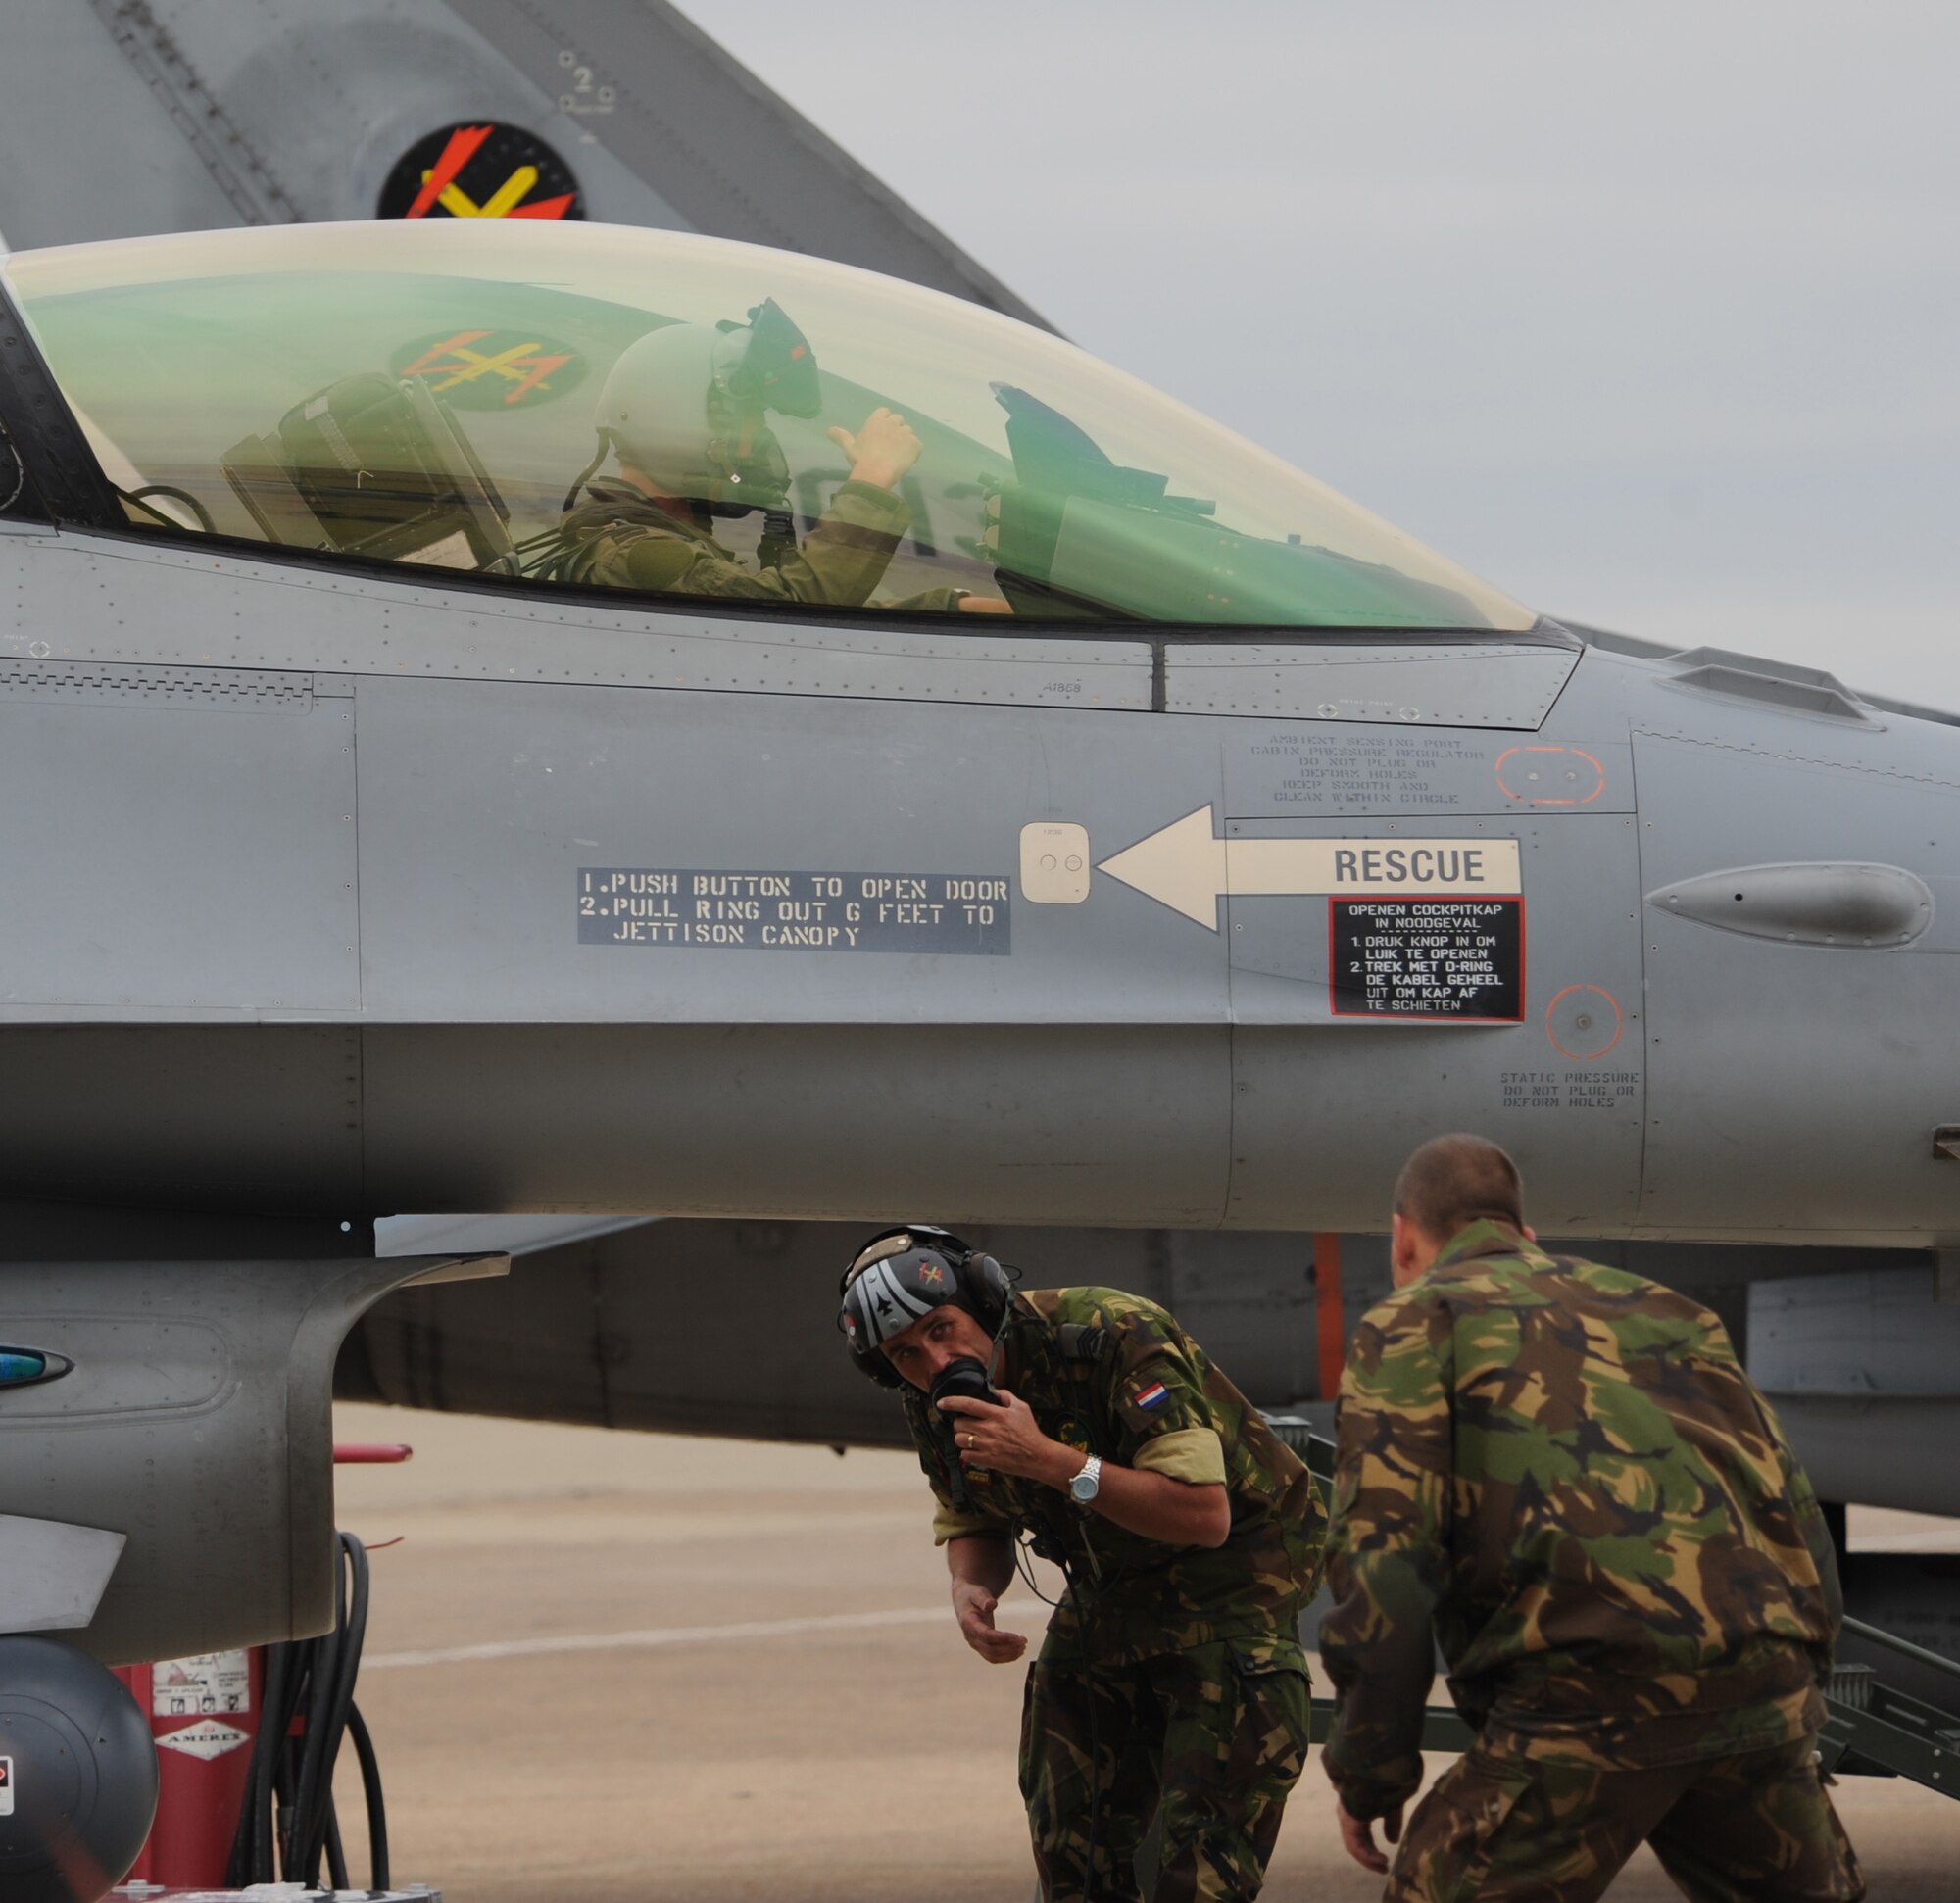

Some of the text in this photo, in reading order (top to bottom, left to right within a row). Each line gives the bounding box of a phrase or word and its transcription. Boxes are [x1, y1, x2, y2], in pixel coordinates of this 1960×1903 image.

[573, 66, 594, 93] 2
[1270, 735, 1462, 749] AMBIENT SENSING PORT
[1250, 746, 1484, 759] CABIN PRESSURE REGULATOR
[1299, 757, 1436, 769] DO NOT PLUG OR
[1300, 768, 1418, 780] DEFORM HOLES
[1283, 779, 1429, 792] KEEP SMOOTH AND
[1274, 792, 1459, 804] CLEAN WITHIN CIRCLE
[1335, 849, 1485, 882] RESCUE
[693, 875, 791, 897] BUTTON
[811, 877, 843, 898] TO
[861, 878, 927, 900] OPEN
[946, 880, 1008, 901] DOOR
[696, 900, 760, 920] RING
[778, 901, 827, 921] OUT
[879, 903, 945, 924] FEET
[962, 905, 994, 925] TO
[1348, 904, 1503, 916] OPENEN COCKPITKAP
[1375, 917, 1482, 929] IN NOODGEVAL
[613, 921, 859, 947] JETTISON CANOPY
[1365, 936, 1404, 948] DRUK
[1410, 936, 1449, 948] KNOP
[1455, 936, 1470, 948] IN
[1476, 936, 1496, 948] OM
[1365, 949, 1489, 960] LUIK TE OPENEN
[1408, 961, 1439, 973] MET
[1445, 961, 1494, 973] D-RING
[1366, 974, 1504, 986] DE KABEL GEHEEL
[1366, 987, 1479, 999] UIT OM KAP AF
[1366, 1000, 1461, 1010] TE SCHIETEN
[1500, 1072, 1639, 1084] STATIC PRESSURE
[1504, 1085, 1635, 1097] DO NOT PLUG OR
[1503, 1097, 1615, 1108] DEFORM HOLES
[169, 1733, 241, 1742] AMEREX
